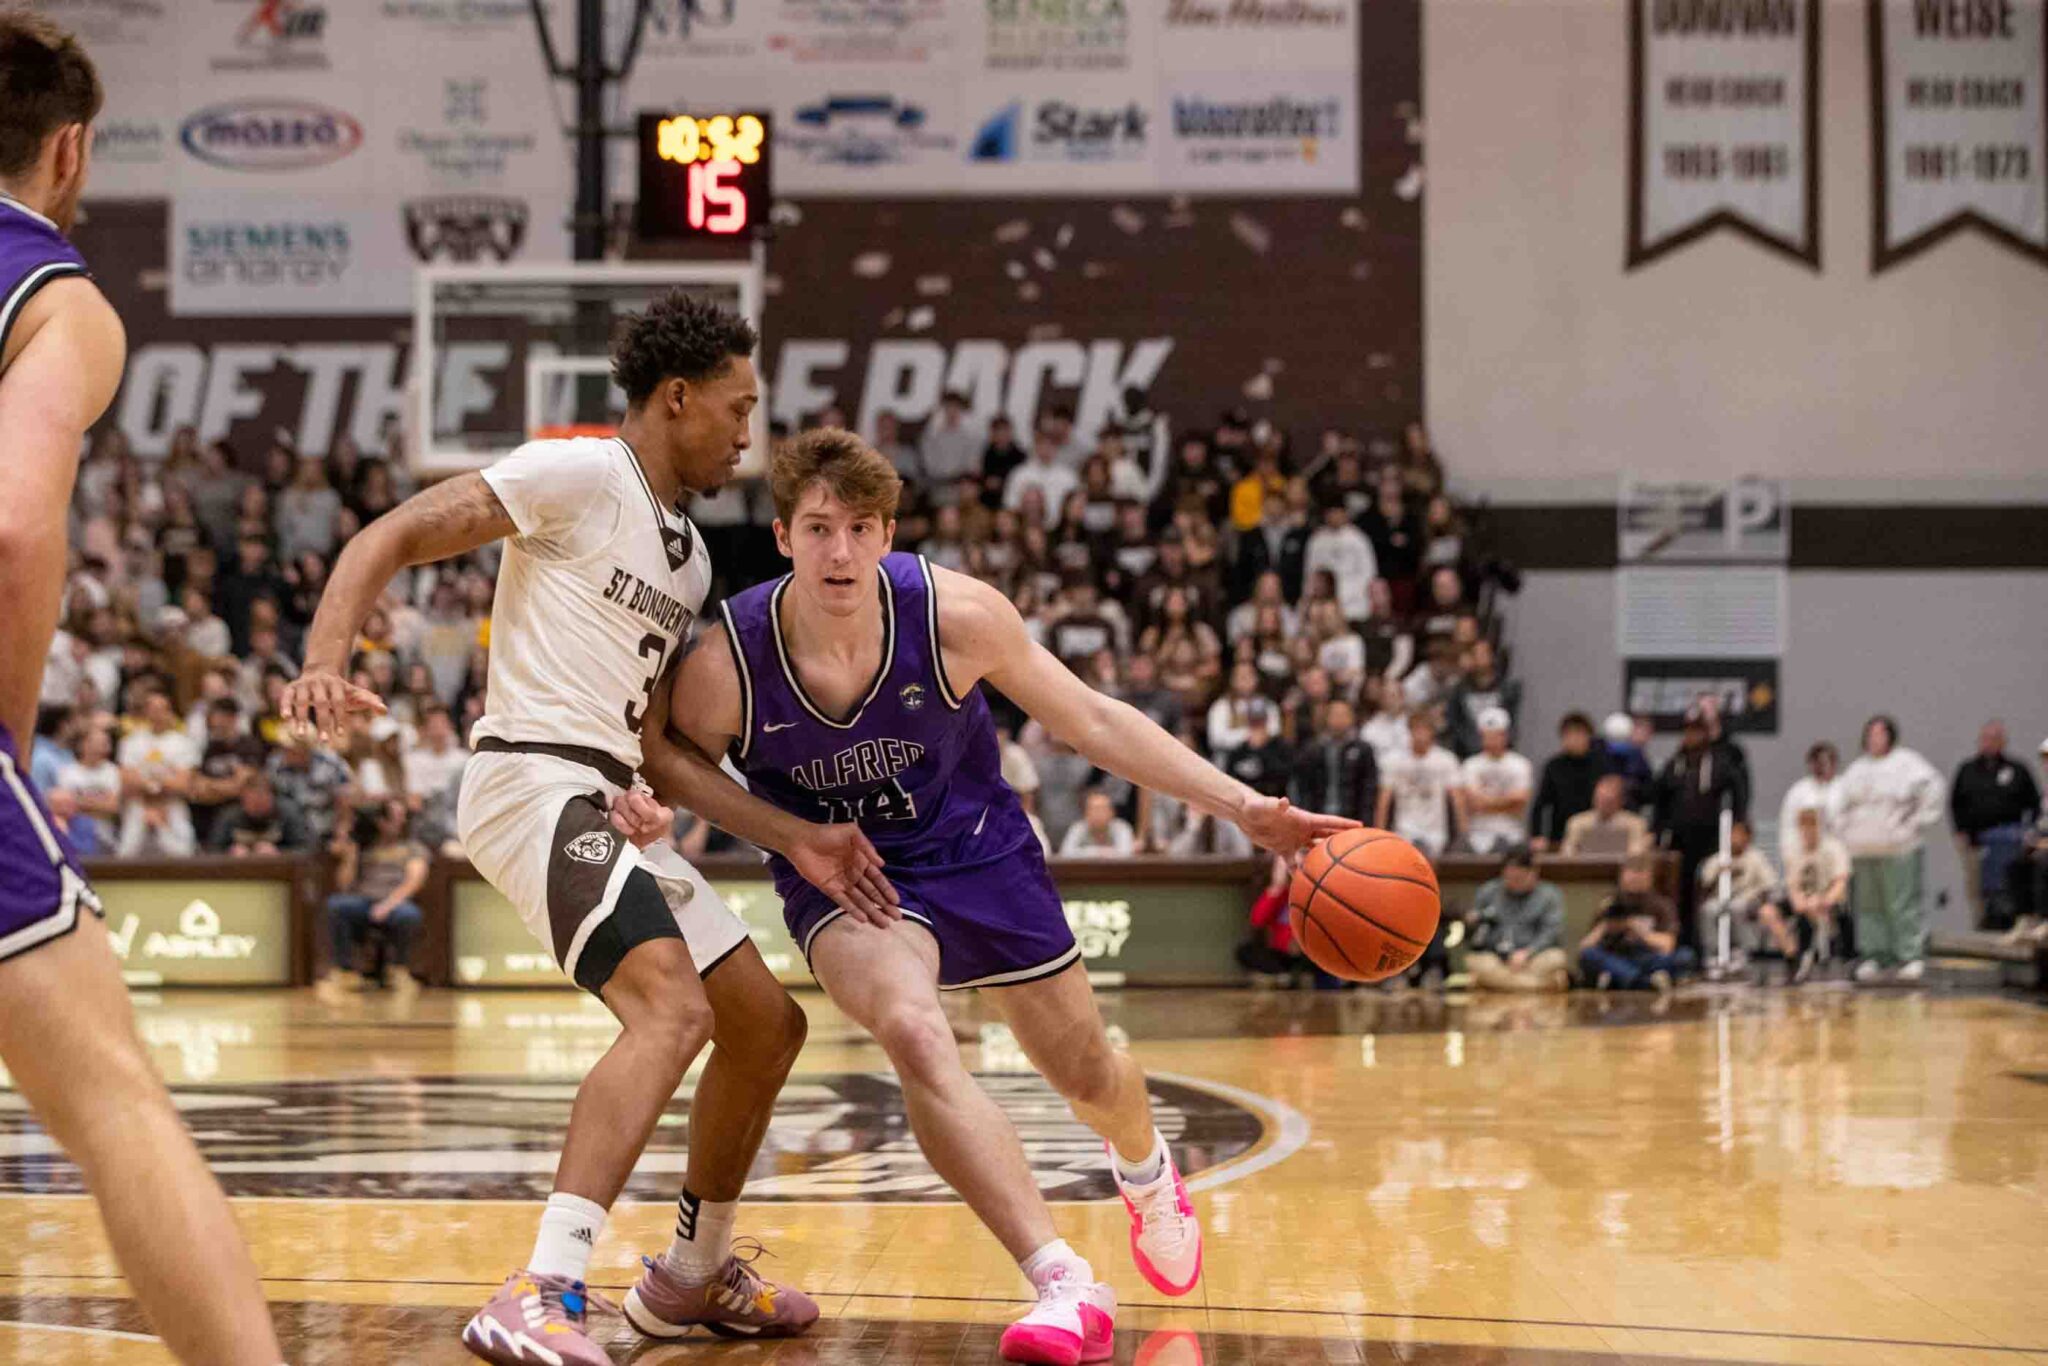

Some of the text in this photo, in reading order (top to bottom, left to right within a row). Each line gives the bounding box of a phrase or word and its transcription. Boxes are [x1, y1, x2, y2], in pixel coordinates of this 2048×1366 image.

[1912, 0, 2016, 38] WEISE
[1033, 100, 1149, 144] Stark
[688, 160, 746, 234] 15
[186, 222, 350, 253] SIEMENS
[117, 342, 282, 456] OF
[603, 566, 696, 640] ST. BONAVENT
[624, 632, 667, 735] 3
[791, 738, 925, 791] ALFRED
